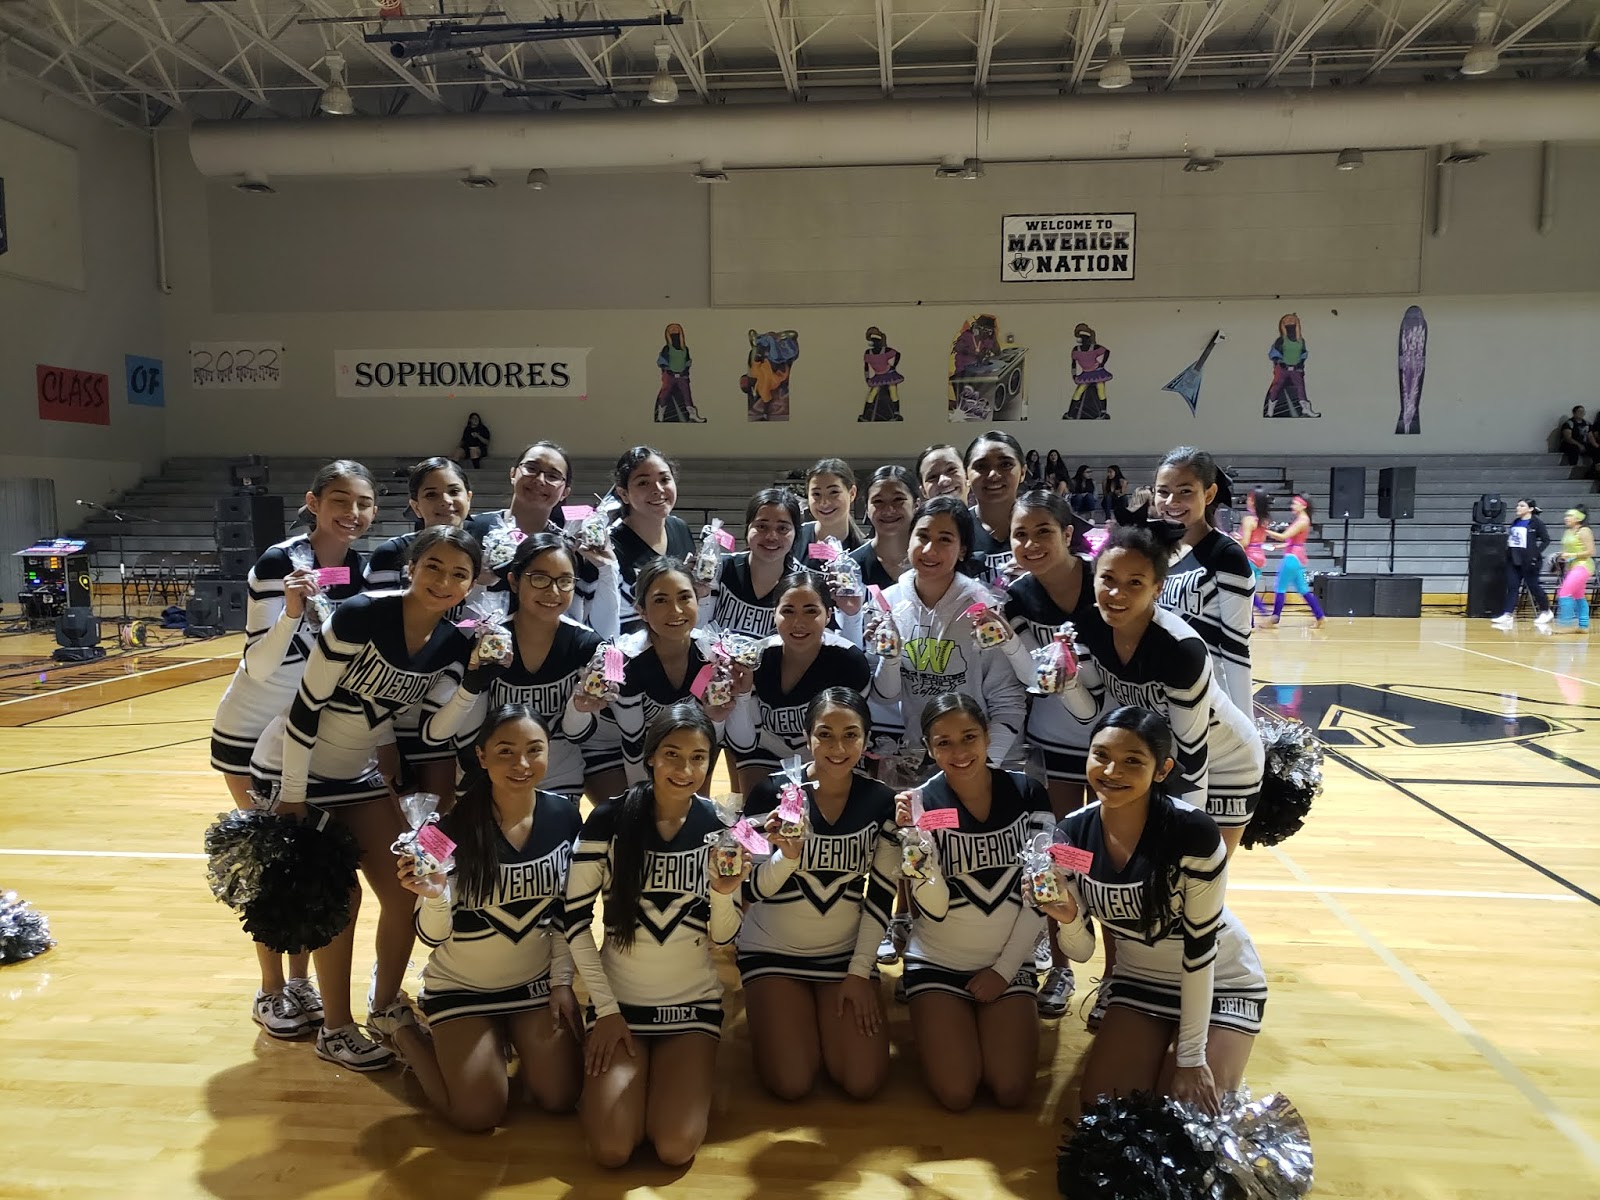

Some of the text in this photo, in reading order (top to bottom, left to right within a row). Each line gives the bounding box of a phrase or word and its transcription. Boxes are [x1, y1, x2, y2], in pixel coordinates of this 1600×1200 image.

[1025, 219, 1113, 231] WELCOME TO
[1007, 231, 1130, 252] MAVERICK
[1036, 254, 1128, 273] NATION
[131, 365, 159, 395] OF
[193, 349, 280, 385] 2022
[355, 361, 571, 389] SOPHOMORES
[42, 371, 104, 407] CLASS
[904, 637, 955, 674] W
[653, 1006, 699, 1024] JUDEA
